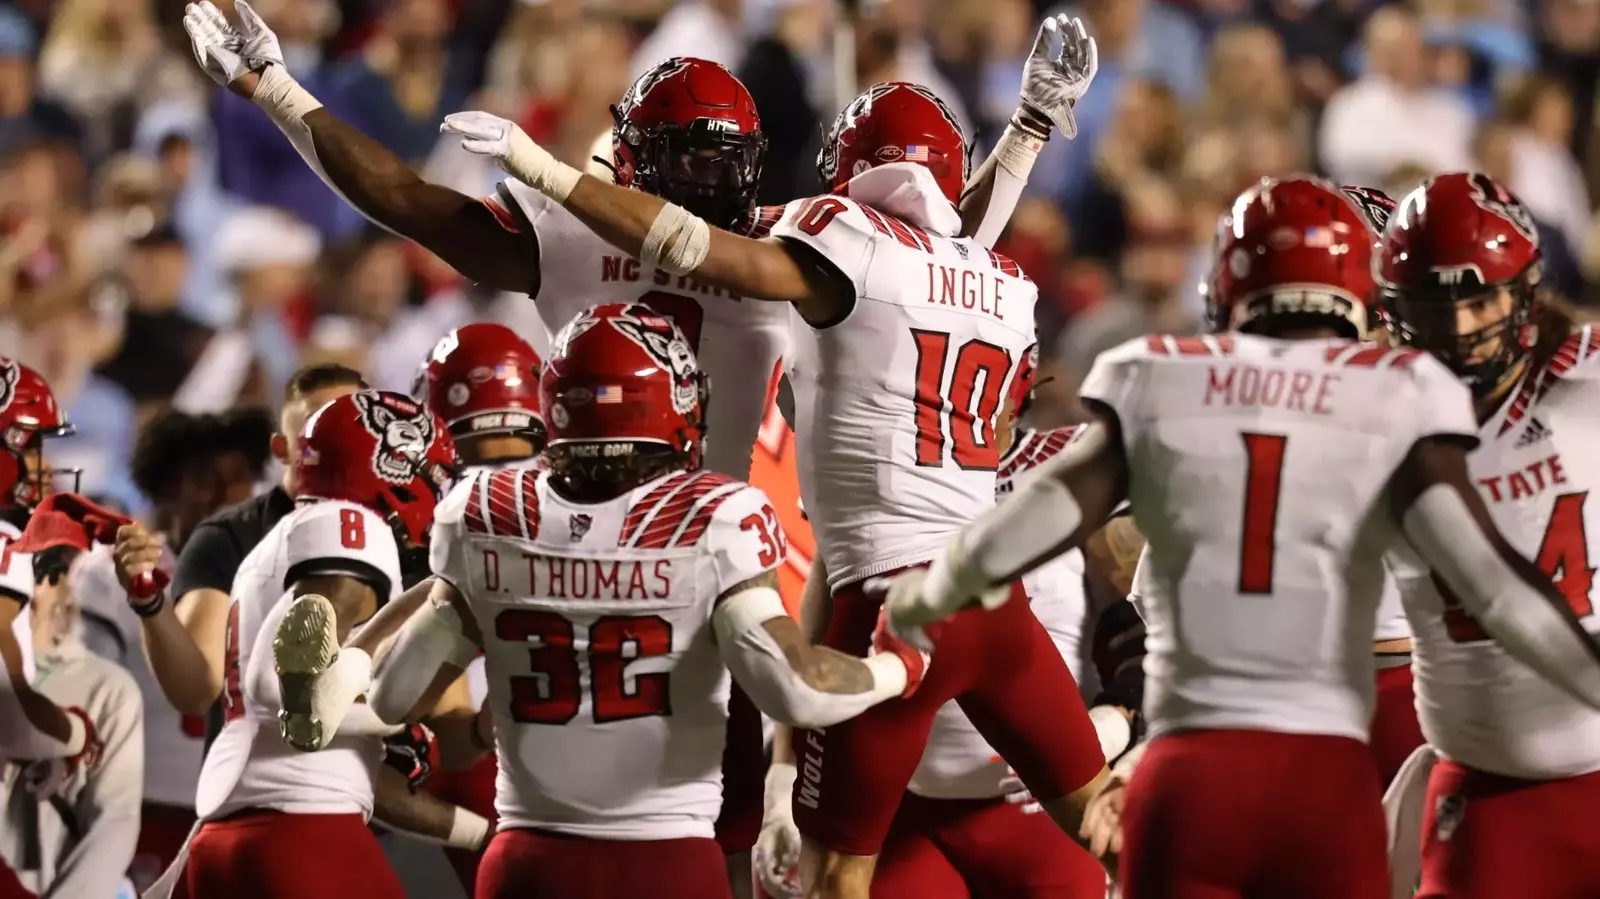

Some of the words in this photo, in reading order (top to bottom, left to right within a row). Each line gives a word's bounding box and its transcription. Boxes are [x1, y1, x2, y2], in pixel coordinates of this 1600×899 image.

[601, 255, 641, 282] NC
[927, 263, 1004, 320] INGLE
[909, 327, 1012, 471] 10
[1203, 365, 1341, 416] MOORE
[1478, 454, 1567, 502] TATE
[339, 508, 366, 550] 8
[739, 504, 787, 568] 32
[1237, 431, 1288, 595] 1
[484, 550, 510, 593] D.
[522, 553, 672, 600] THOMAS
[495, 607, 673, 726] 32
